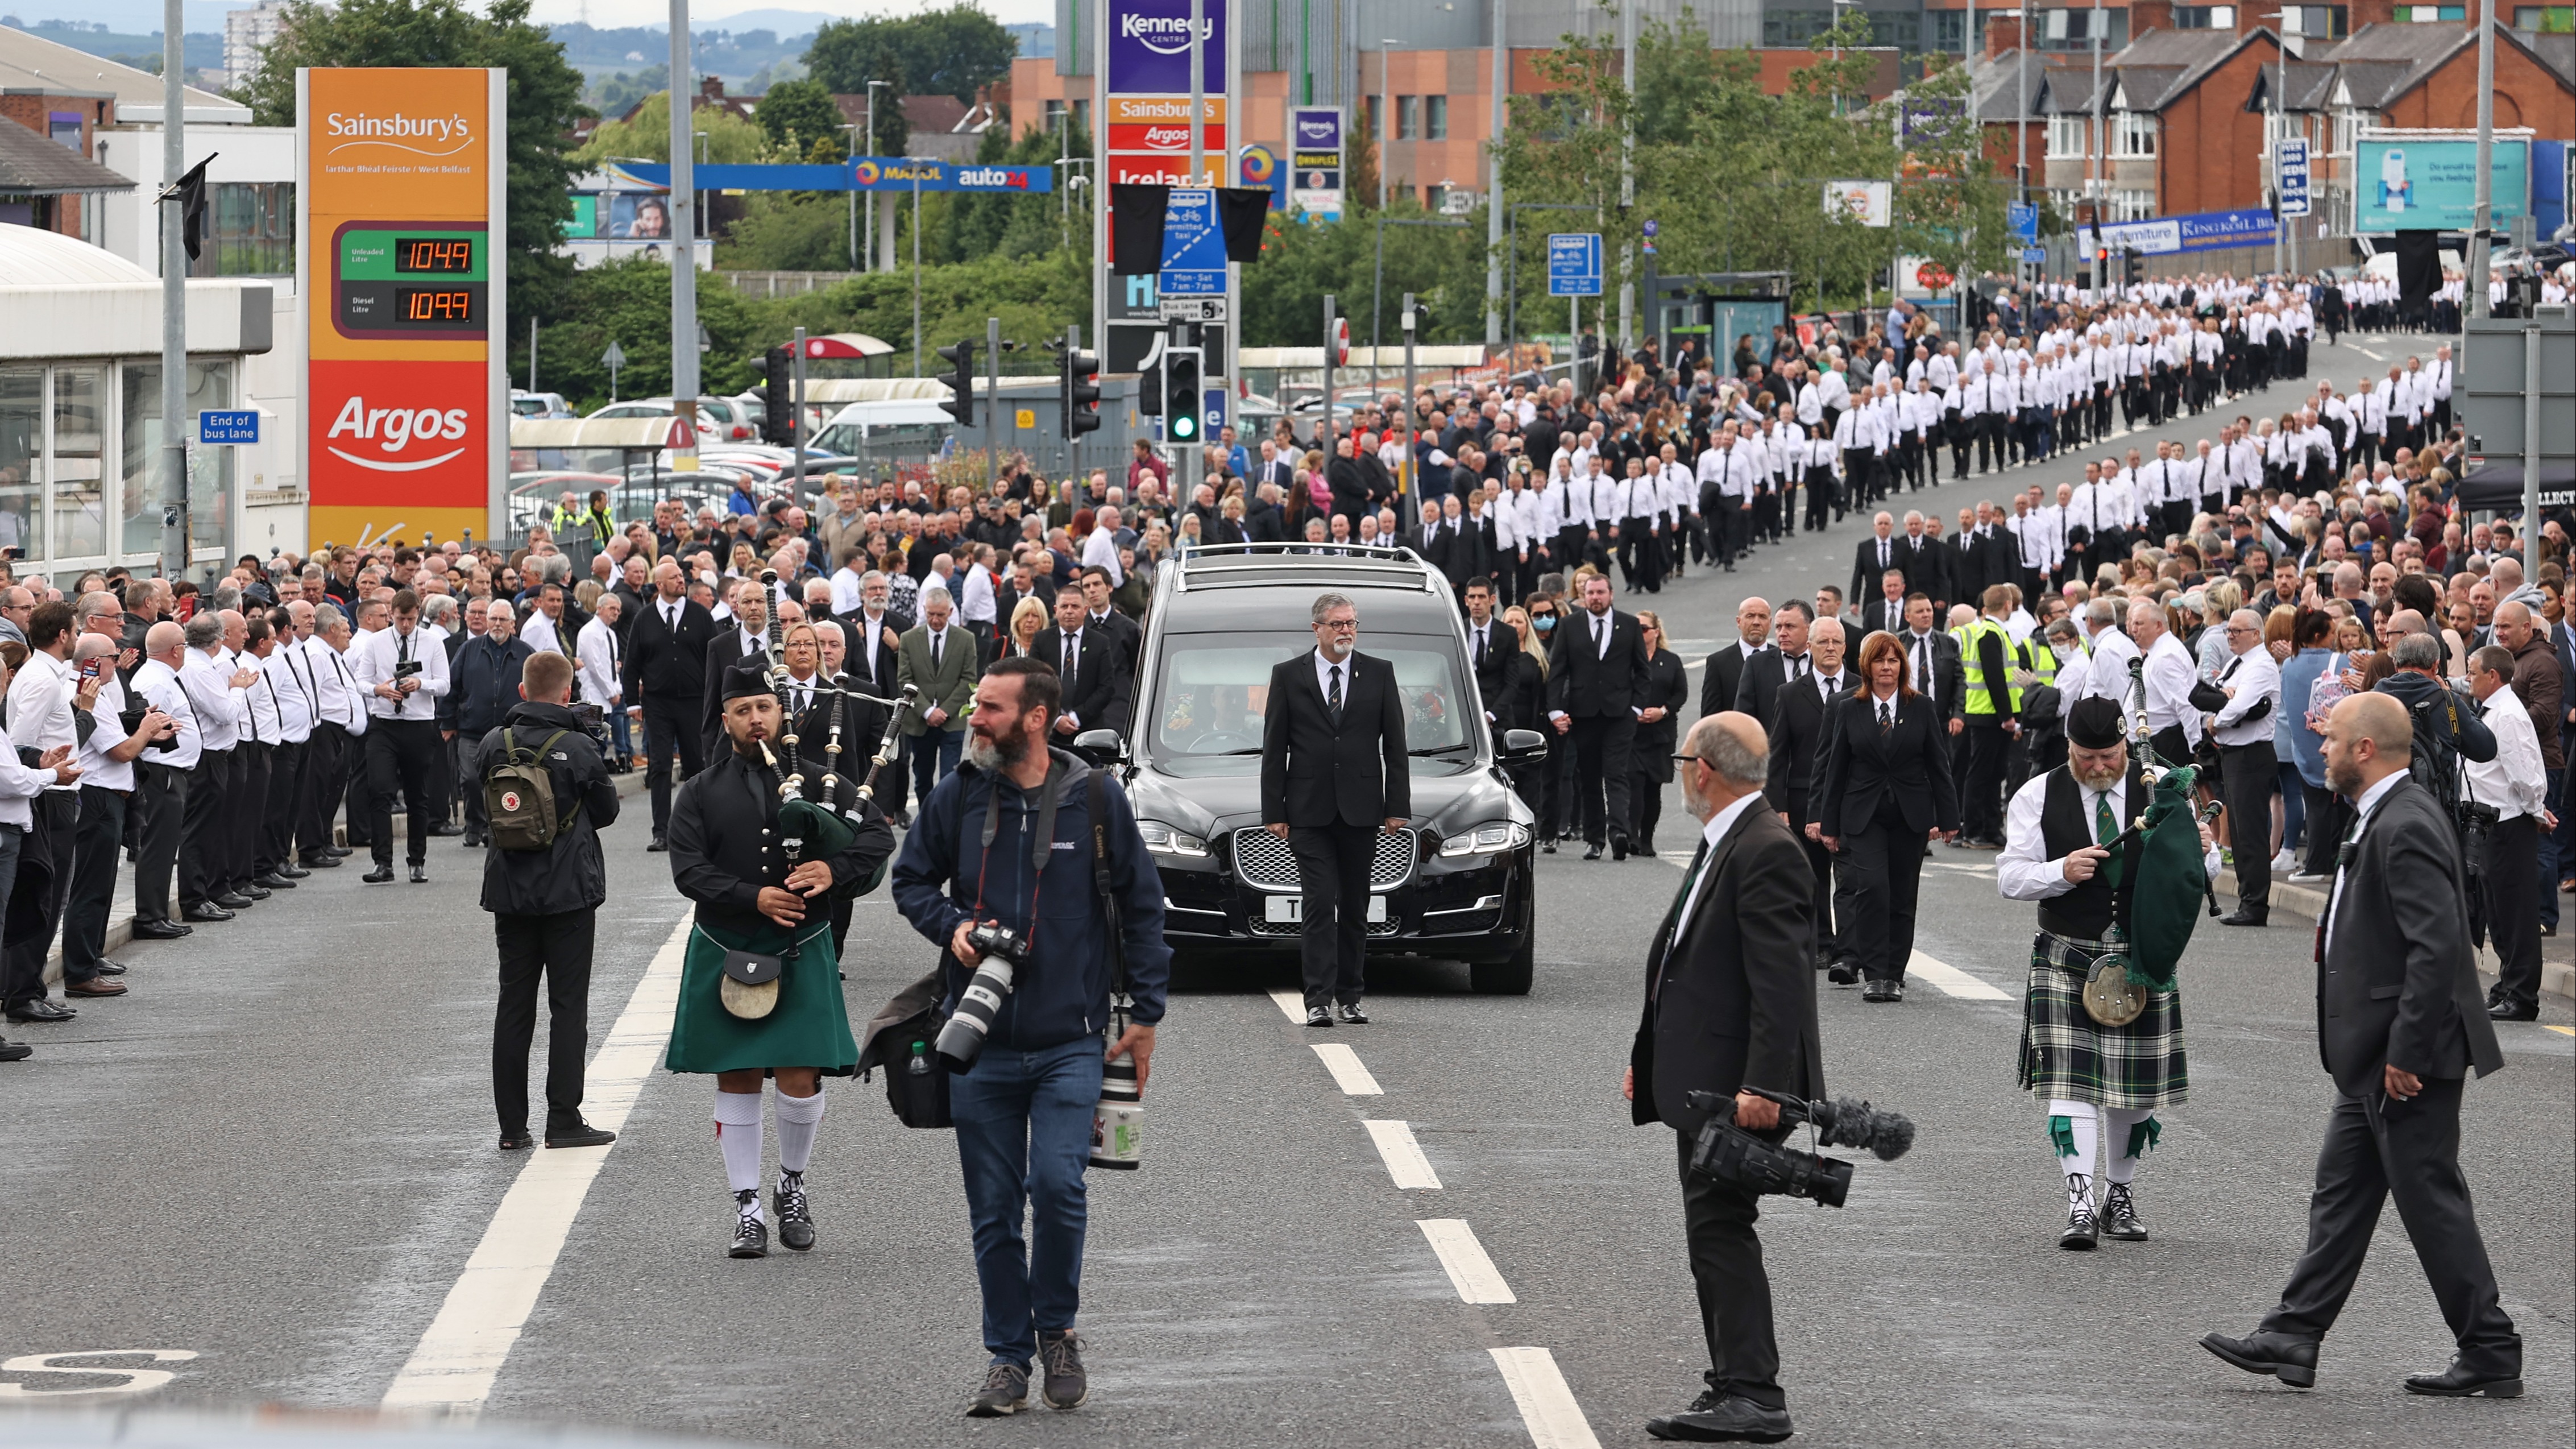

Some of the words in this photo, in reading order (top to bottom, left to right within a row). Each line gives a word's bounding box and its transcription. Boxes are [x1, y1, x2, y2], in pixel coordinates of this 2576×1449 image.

[1119, 101, 1215, 118] Sainsbur's
[327, 113, 468, 142] Sainsbury's
[1144, 126, 1189, 144] Argos
[442, 165, 471, 174] Belfast
[959, 167, 1028, 190] auto24
[409, 243, 470, 268] 104.9
[409, 292, 469, 319] 109.9
[210, 415, 233, 426] End
[237, 415, 249, 426] of
[327, 396, 468, 452] Argos
[205, 428, 225, 438] bus
[229, 428, 254, 439] lane
[1094, 825, 1104, 858] Canon
